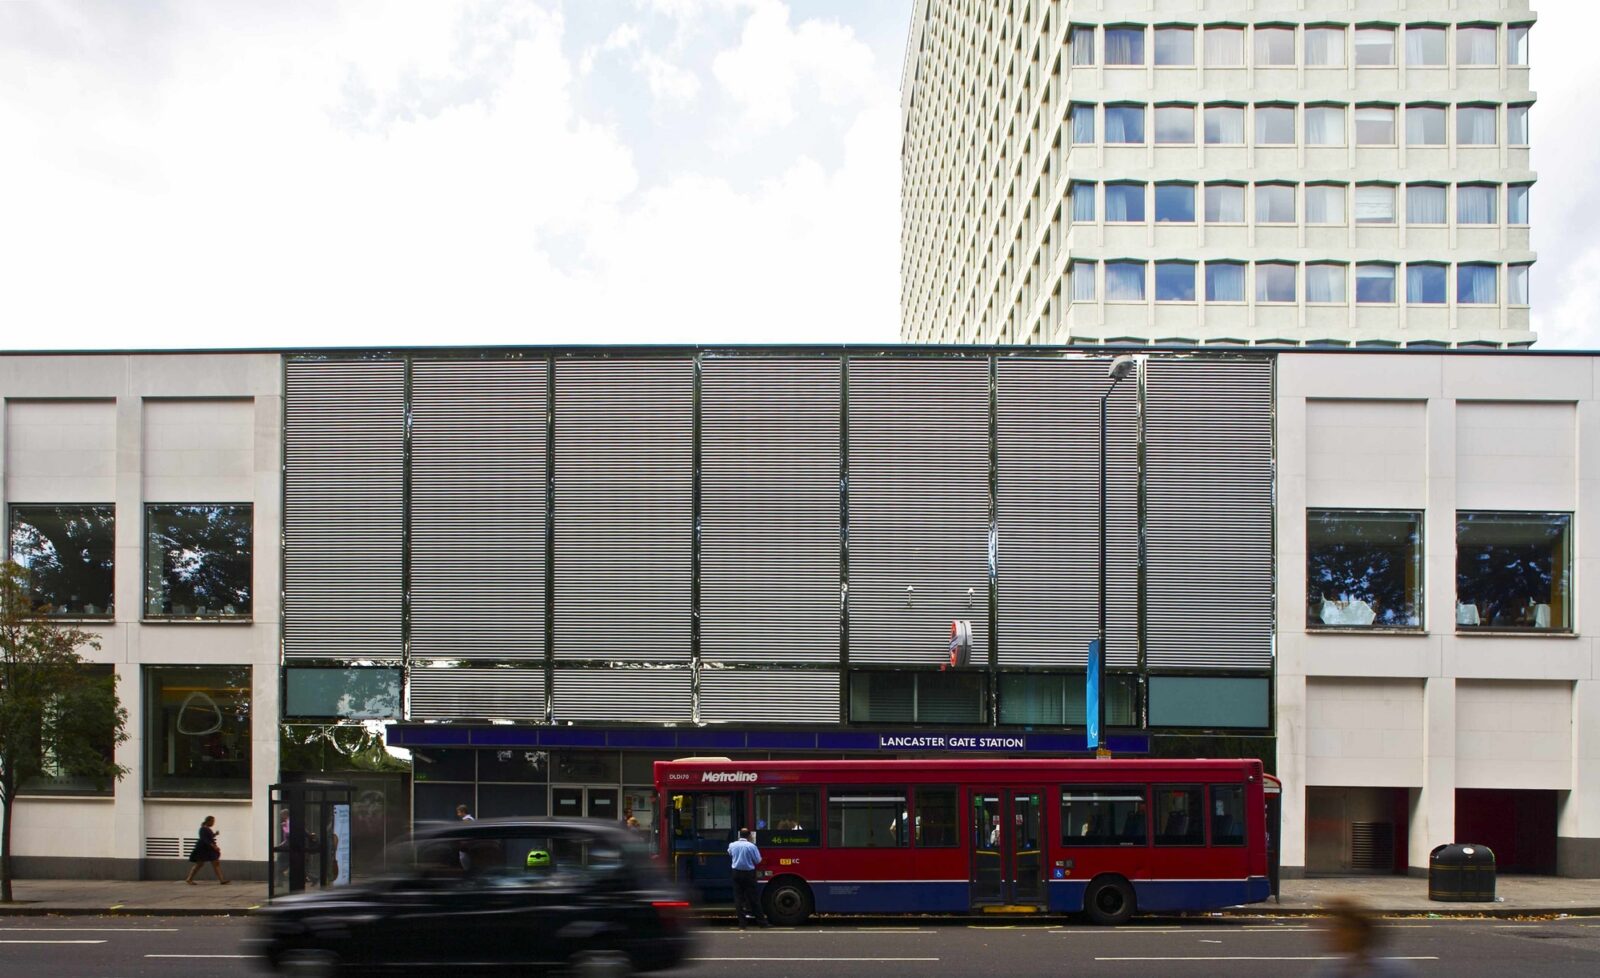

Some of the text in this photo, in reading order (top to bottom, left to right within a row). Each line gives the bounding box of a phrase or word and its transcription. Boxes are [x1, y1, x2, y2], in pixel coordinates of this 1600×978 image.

[881, 737, 1024, 748] LANCASTER GATE STATION
[702, 772, 757, 782] Metroline
